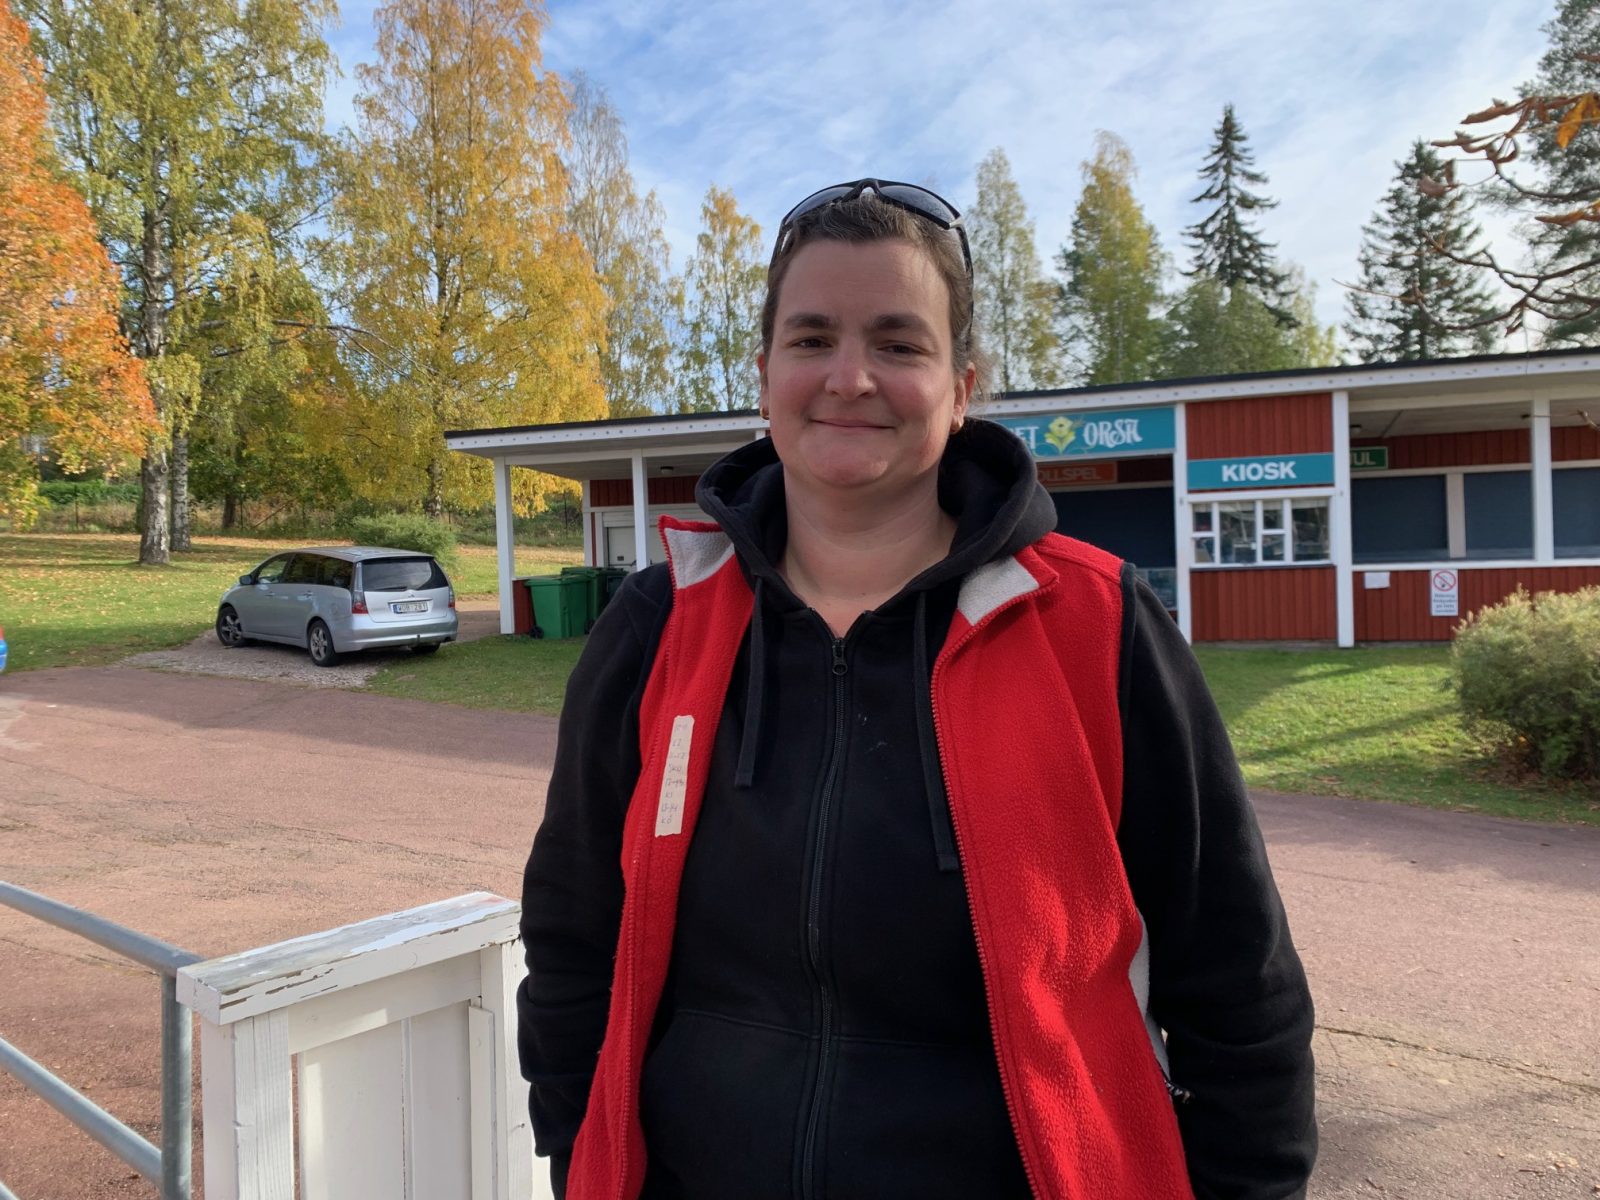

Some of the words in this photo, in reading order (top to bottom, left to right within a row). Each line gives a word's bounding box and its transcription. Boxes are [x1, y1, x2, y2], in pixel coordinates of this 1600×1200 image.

[1011, 426, 1040, 450] ET
[1083, 418, 1143, 448] ORSA
[1350, 451, 1377, 466] UL
[1222, 461, 1297, 482] KIOSK
